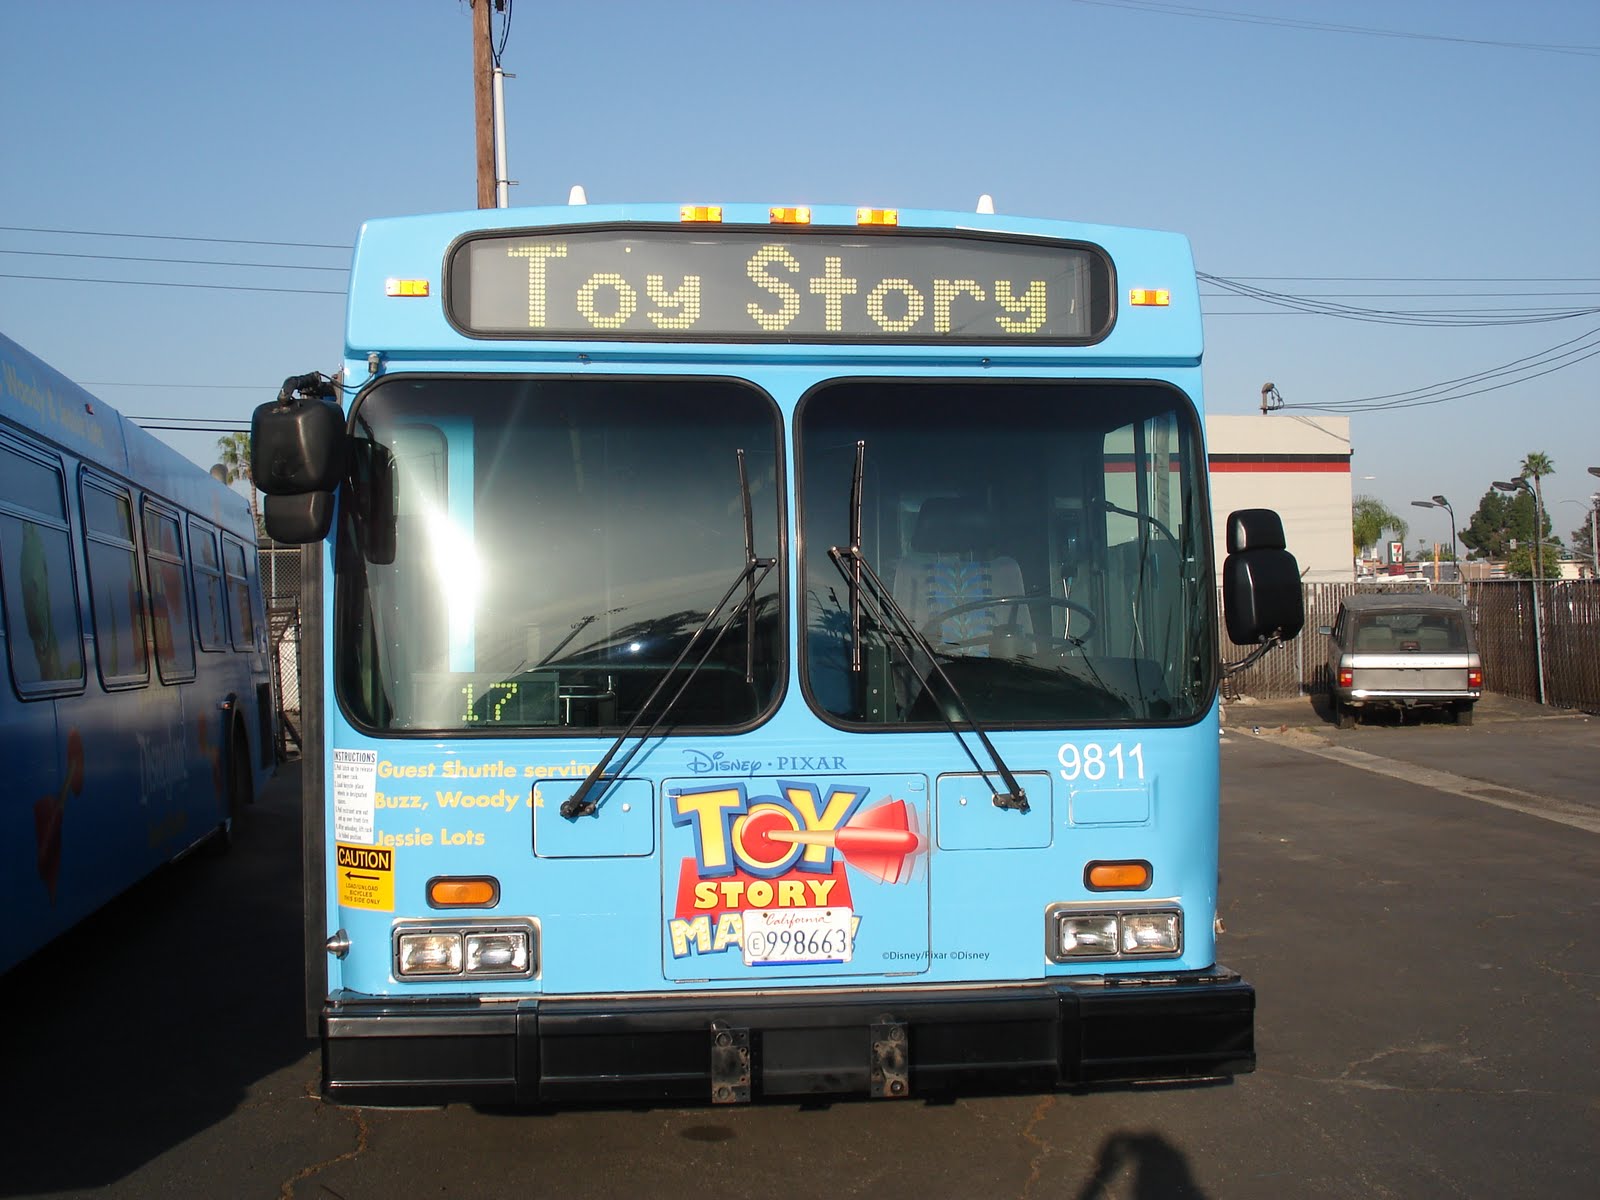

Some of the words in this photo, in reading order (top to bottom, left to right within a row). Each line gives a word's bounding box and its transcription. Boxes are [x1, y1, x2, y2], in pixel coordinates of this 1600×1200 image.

[507, 243, 700, 328] Toy
[747, 245, 1046, 333] Story
[461, 683, 518, 721] 17
[378, 761, 435, 778] Guest
[442, 760, 517, 778] Shuttle
[523, 760, 605, 779] servin
[682, 749, 762, 778] Disney
[776, 756, 848, 770] PIXAR
[1057, 743, 1144, 780] 9811
[374, 791, 429, 811] Buzz,
[436, 789, 519, 812] Woody
[526, 790, 544, 808] &
[375, 828, 433, 847] Jessie
[440, 828, 486, 846] Lots
[667, 779, 872, 879] TOY
[338, 848, 389, 869] CAUTION
[349, 890, 373, 898] BICYCLES
[694, 879, 837, 910] STORY
[766, 913, 830, 929] California
[766, 928, 846, 957] 998663
[949, 951, 990, 961] ©Disney
